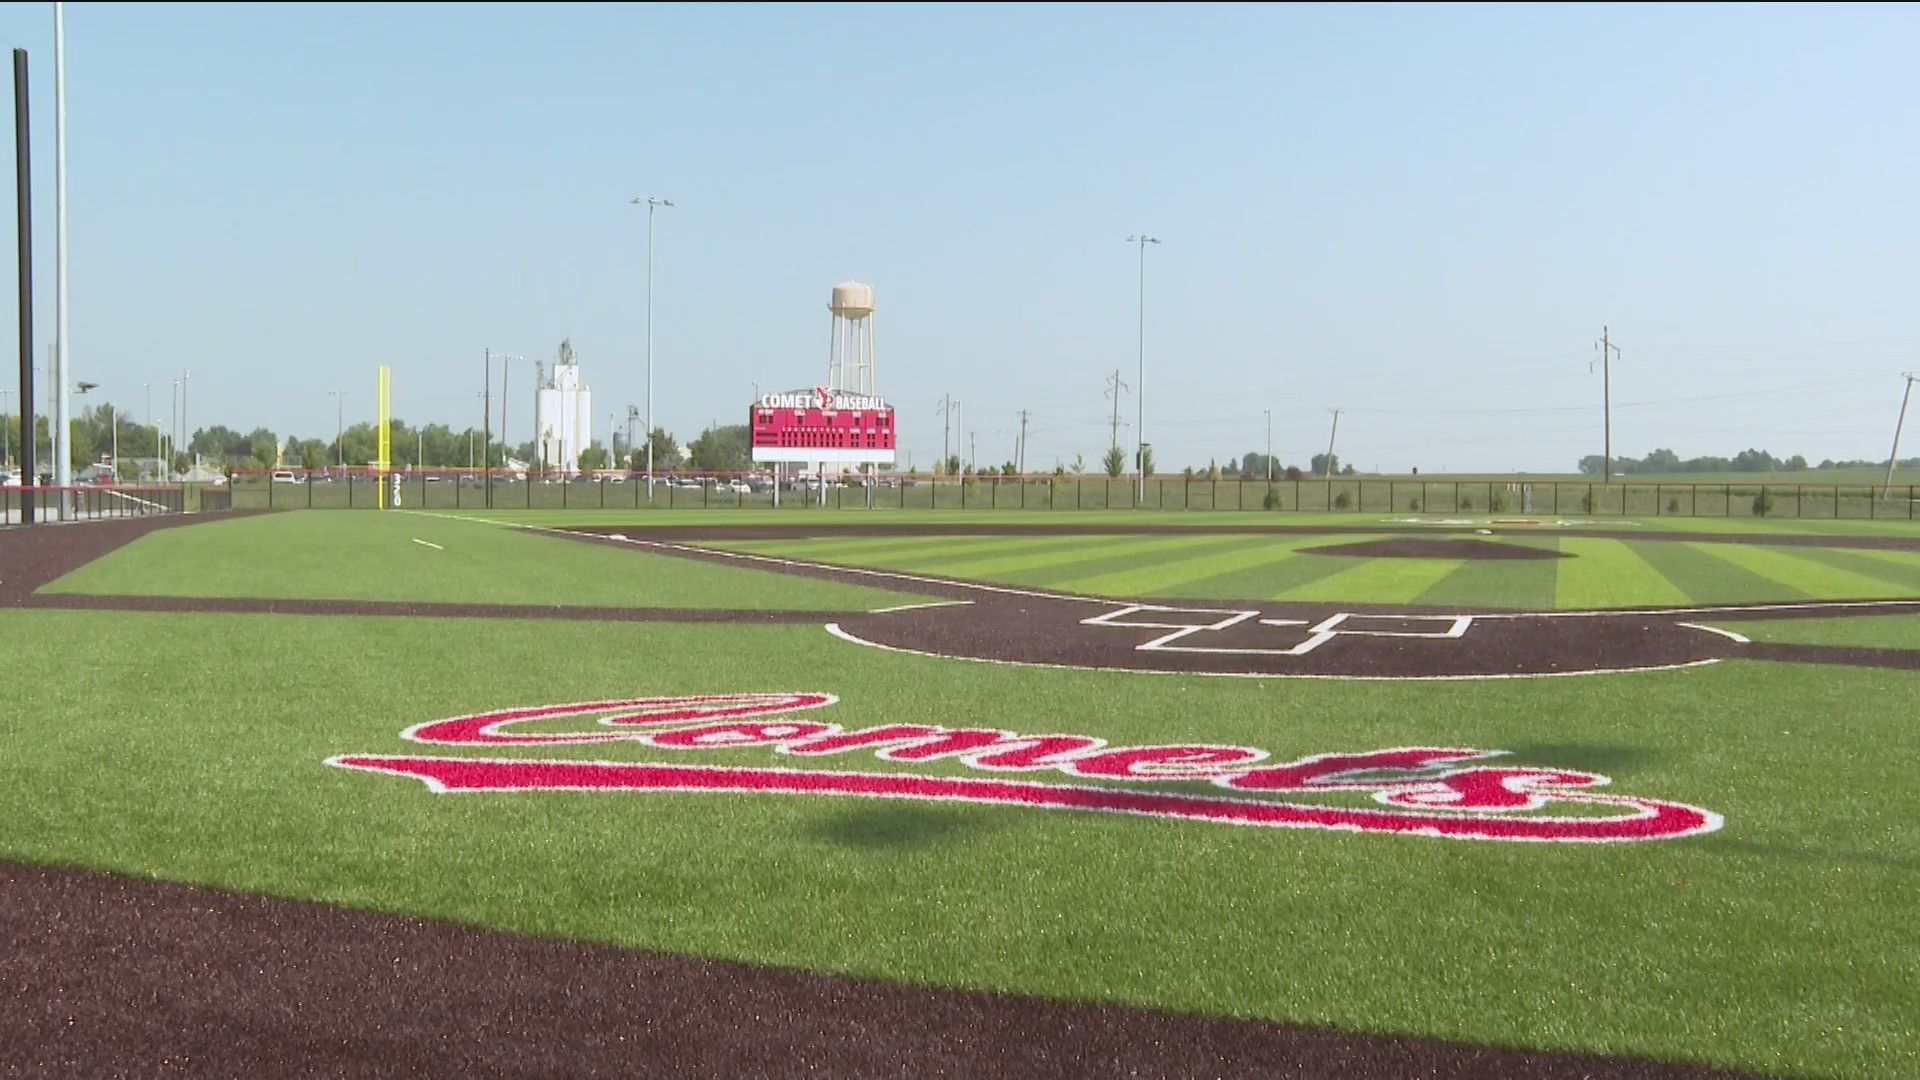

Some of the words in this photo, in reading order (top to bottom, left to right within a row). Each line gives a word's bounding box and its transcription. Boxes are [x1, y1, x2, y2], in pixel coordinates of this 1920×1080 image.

[761, 393, 812, 409] COMET
[836, 396, 886, 410] BASEBALL
[400, 691, 1614, 813] Comets
